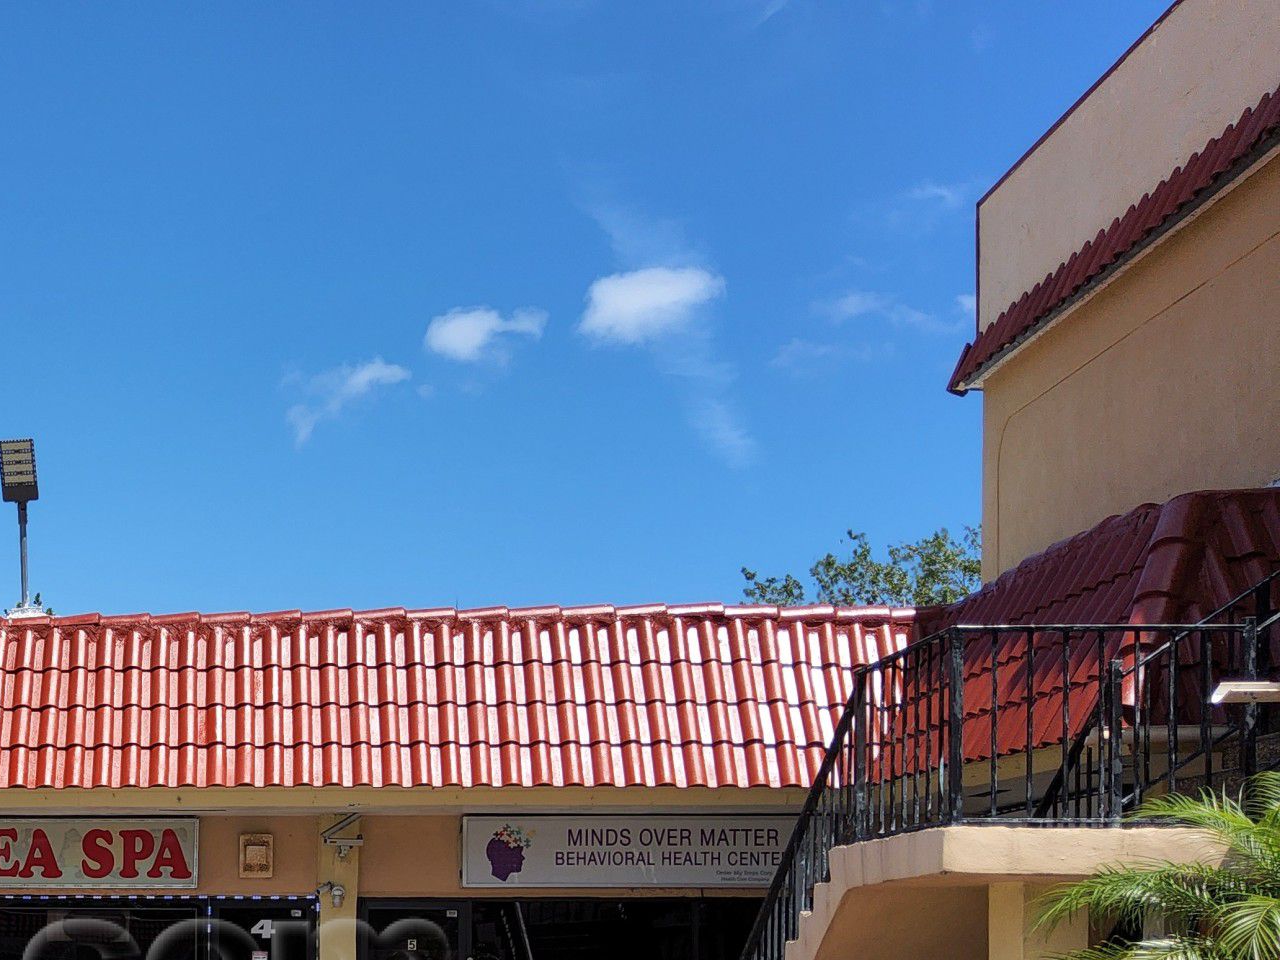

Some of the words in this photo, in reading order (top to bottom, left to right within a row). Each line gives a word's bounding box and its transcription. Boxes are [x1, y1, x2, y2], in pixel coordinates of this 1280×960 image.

[567, 828, 632, 847] MINDS
[639, 828, 692, 847] OVER
[700, 828, 779, 847] MATTER
[81, 828, 192, 879] SPA
[555, 851, 656, 866] BEHAVIORAL
[662, 851, 721, 866] HEALTH
[727, 851, 785, 866] CENTE
[250, 919, 276, 939] 4
[408, 940, 416, 950] 5
